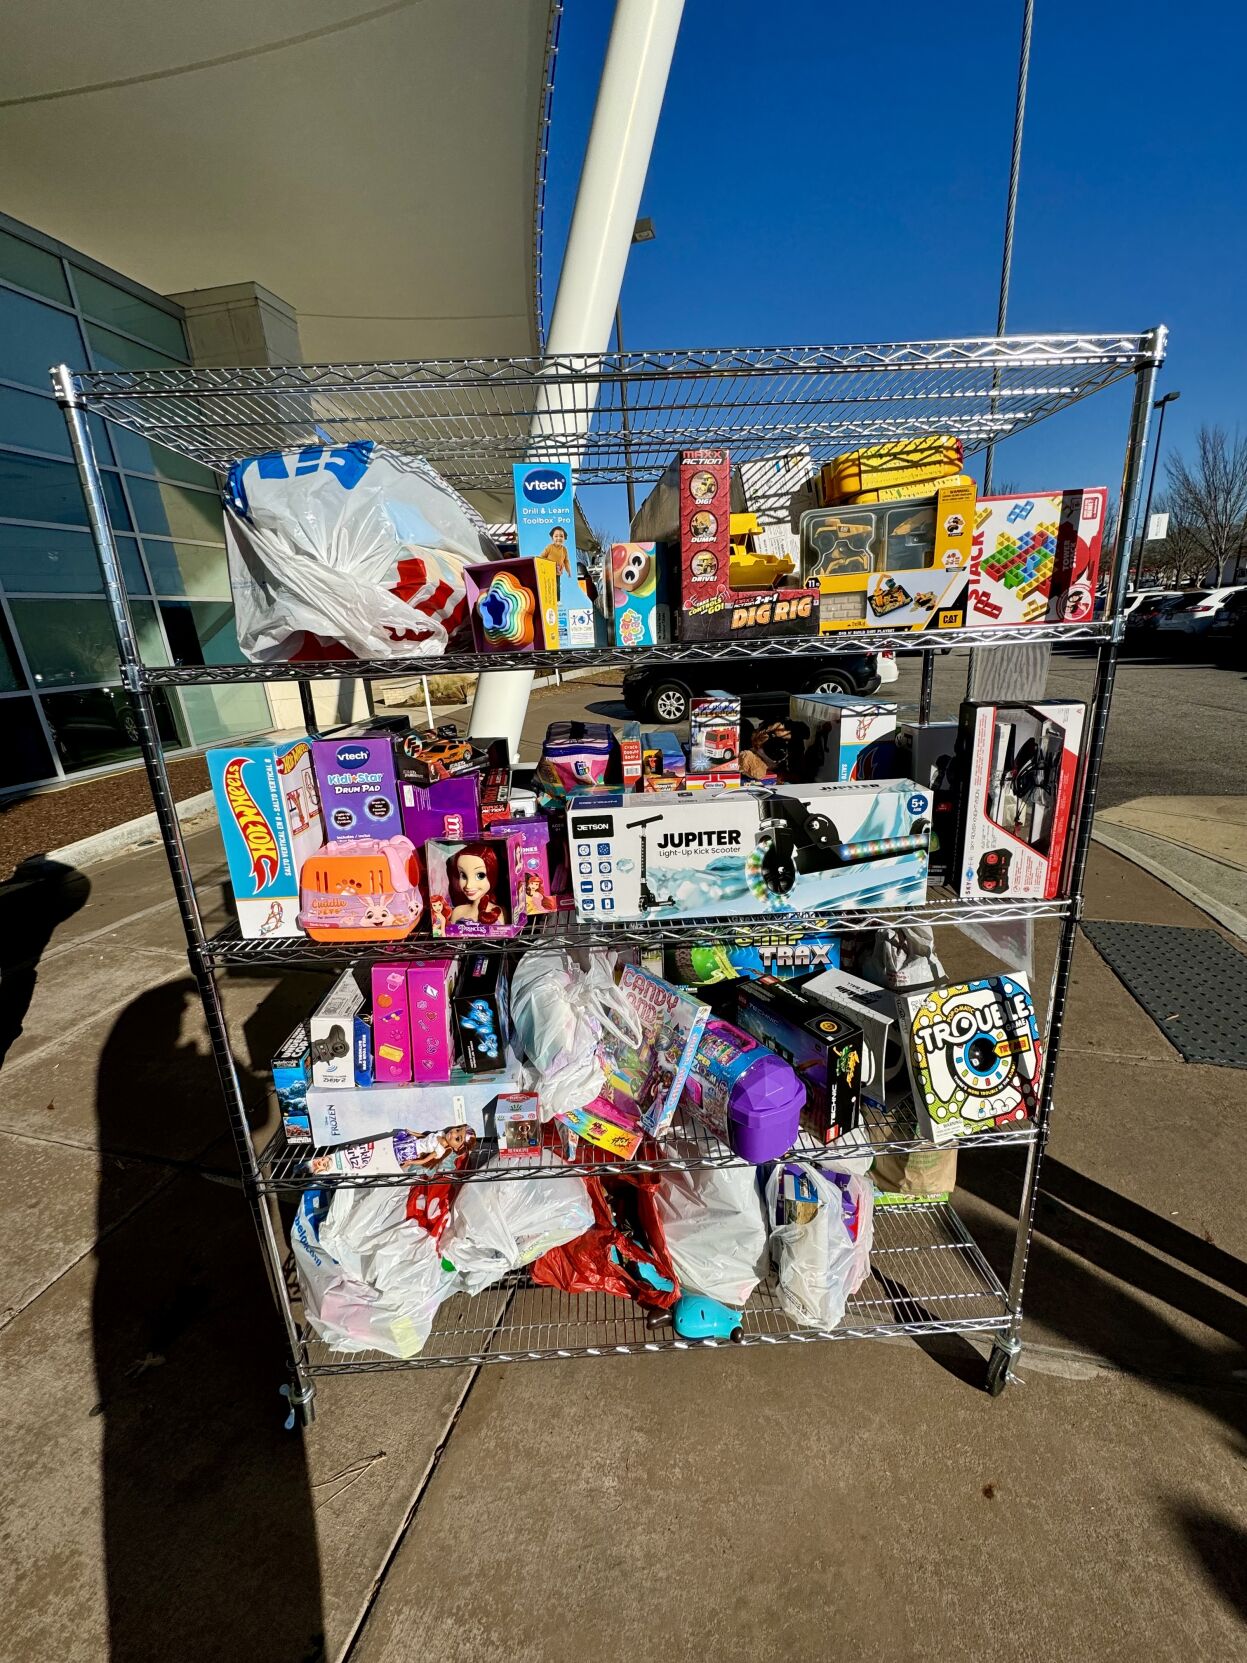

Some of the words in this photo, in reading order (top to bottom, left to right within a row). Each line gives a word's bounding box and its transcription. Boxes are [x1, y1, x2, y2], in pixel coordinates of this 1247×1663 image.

[525, 479, 564, 490] vtech
[1062, 540, 1070, 572] TOWER
[807, 580, 815, 588] 11
[688, 598, 722, 616] CONTROLS
[708, 602, 724, 614] GO!
[731, 603, 771, 630] DIG
[774, 596, 812, 622] RIG
[943, 614, 958, 624] CAT
[337, 751, 369, 760] vtech
[267, 764, 277, 793] VERTICAL
[335, 786, 360, 794] DRUM
[362, 784, 380, 792] PAD
[273, 794, 281, 812] SALTO
[912, 799, 924, 808] 5+
[245, 820, 278, 861] HOT
[279, 832, 288, 858] VERTICAL
[657, 830, 741, 848] JUPITER
[660, 850, 692, 858] Light-Up
[283, 859, 291, 876] SALTO
[759, 944, 833, 966] TRAX
[623, 968, 679, 1013] CANDY
[915, 994, 1030, 1053] TROUBLE
[1006, 1019, 1026, 1030] GAME
[328, 1105, 340, 1136] FROZEN
